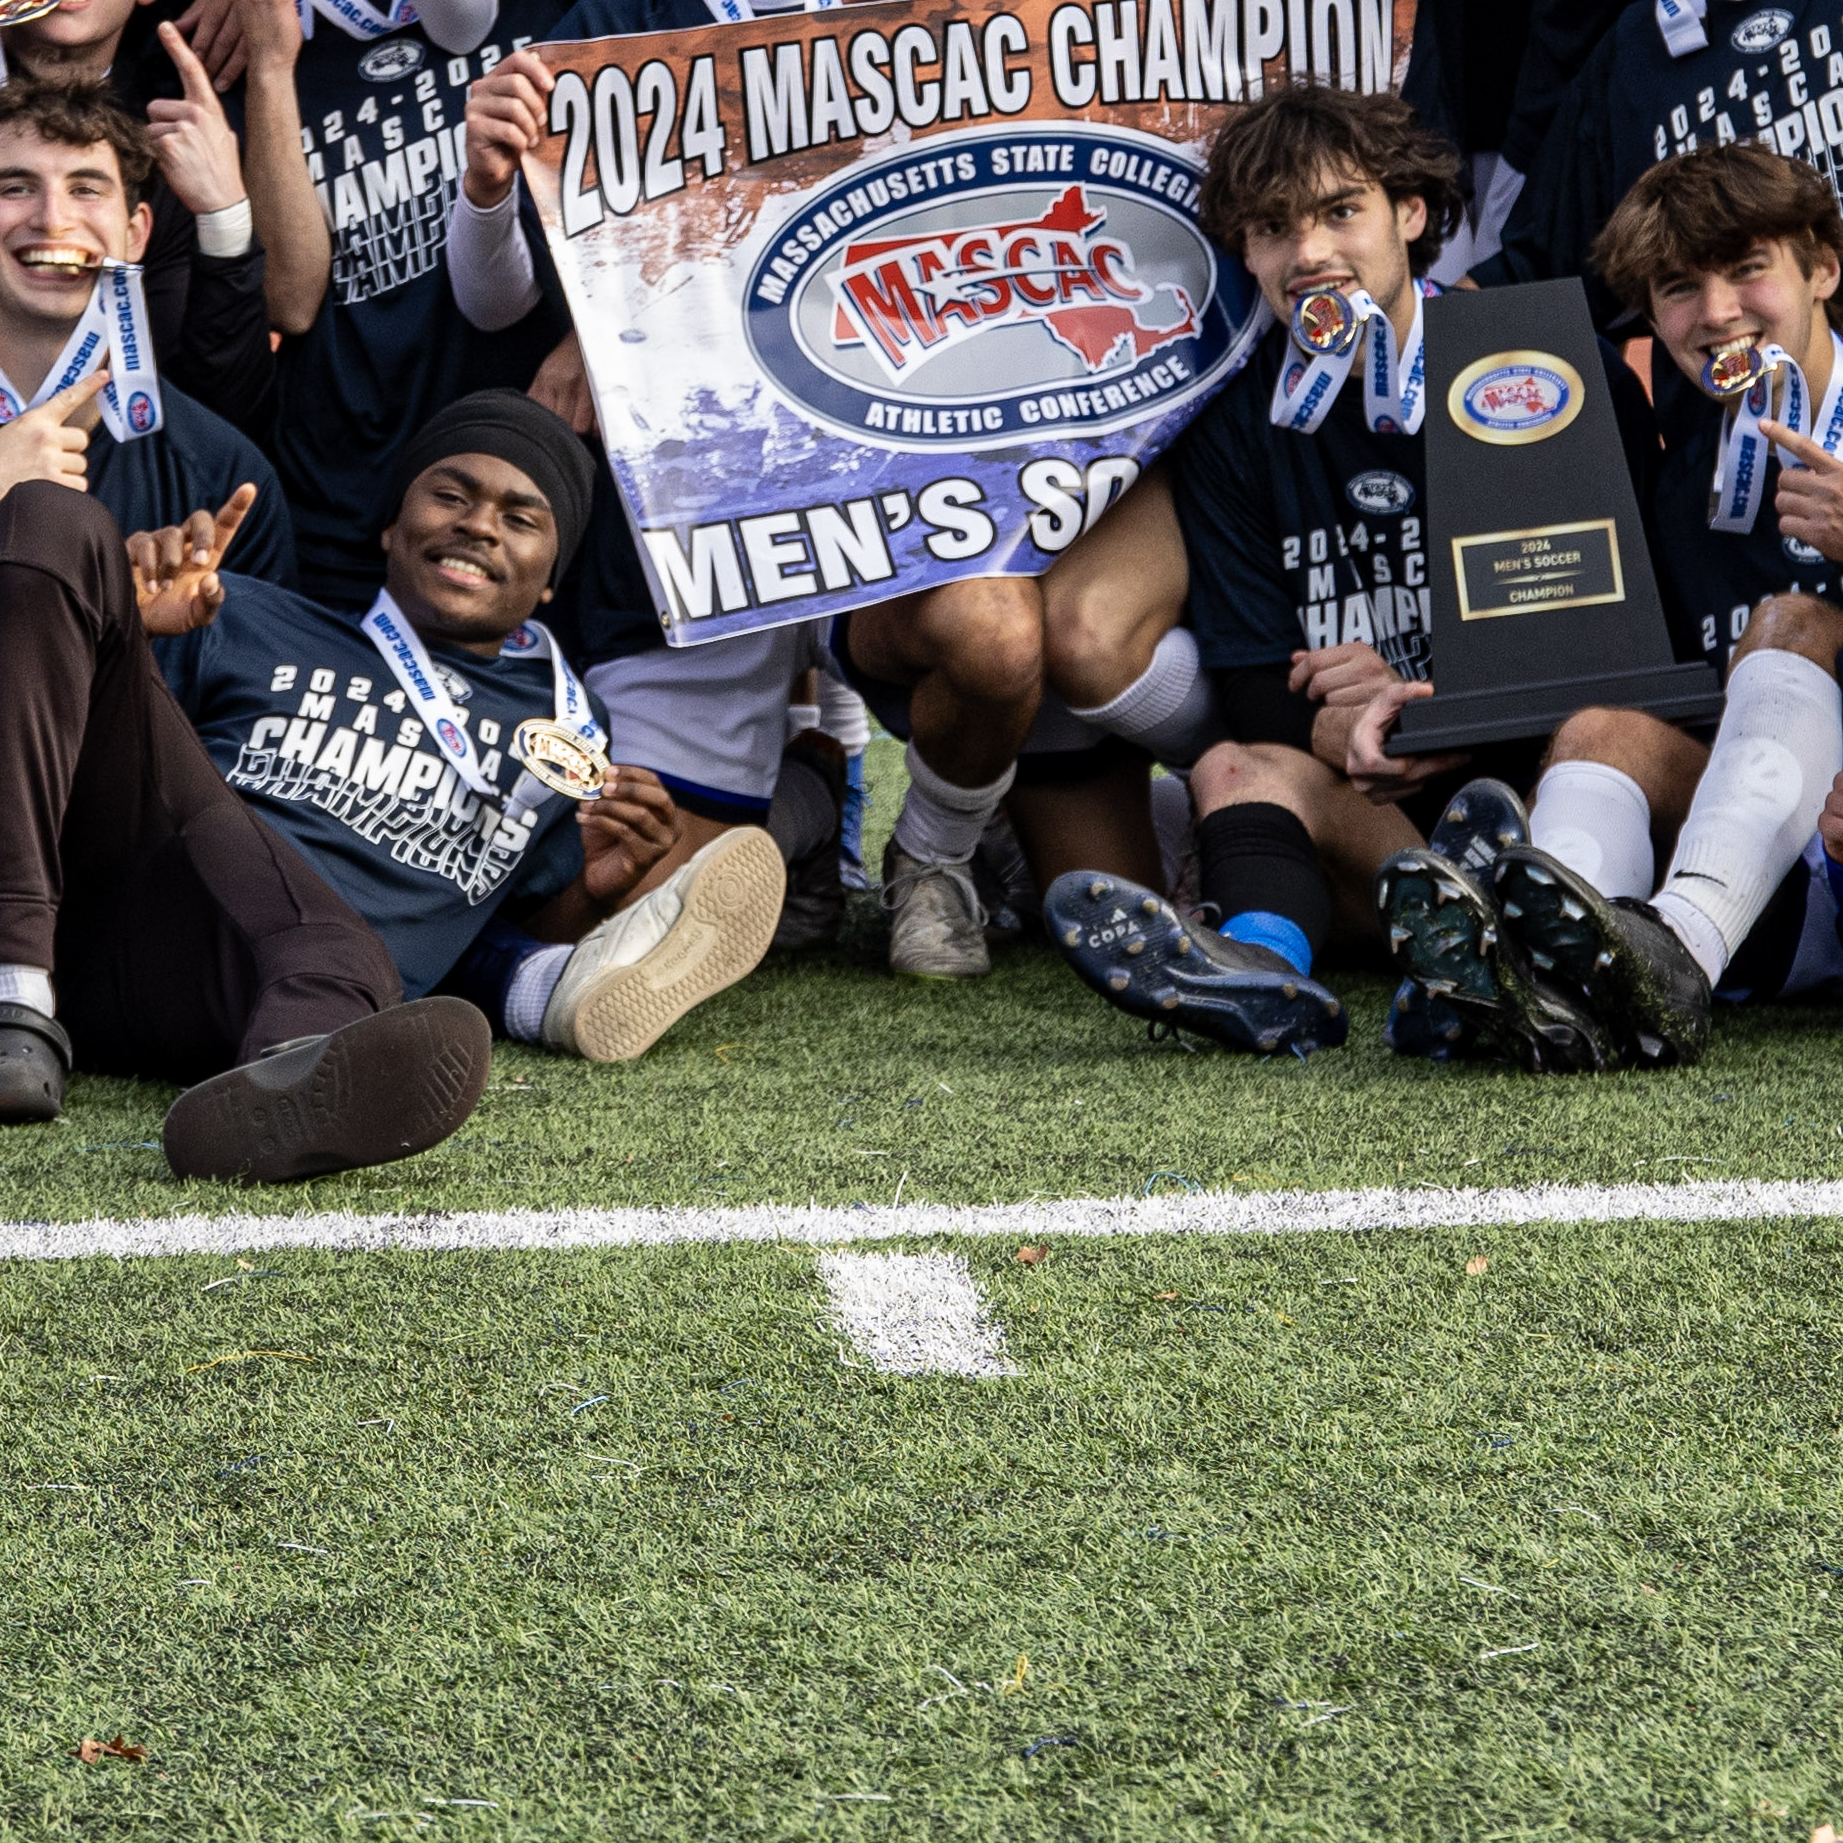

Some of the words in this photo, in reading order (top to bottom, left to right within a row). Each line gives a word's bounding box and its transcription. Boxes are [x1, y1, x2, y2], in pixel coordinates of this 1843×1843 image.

[551, 55, 730, 238] 2024
[741, 14, 1031, 160] MASCAC
[757, 153, 976, 306] MASSACHUSETTS
[992, 144, 1076, 175] STATE
[1090, 147, 1202, 214] COLLEGI
[842, 237, 1142, 368] MASCAC
[865, 401, 1004, 435] ATHLETIC
[1019, 356, 1191, 424] CONFERENCE
[644, 479, 995, 618] MEN'S
[1494, 556, 1531, 573] MEN'S
[1534, 551, 1581, 568] SOCCER
[1521, 539, 1551, 553] 2024
[1509, 584, 1574, 603] CHAMPION
[373, 612, 437, 701] mascac.com
[1088, 921, 1140, 948] COPA
